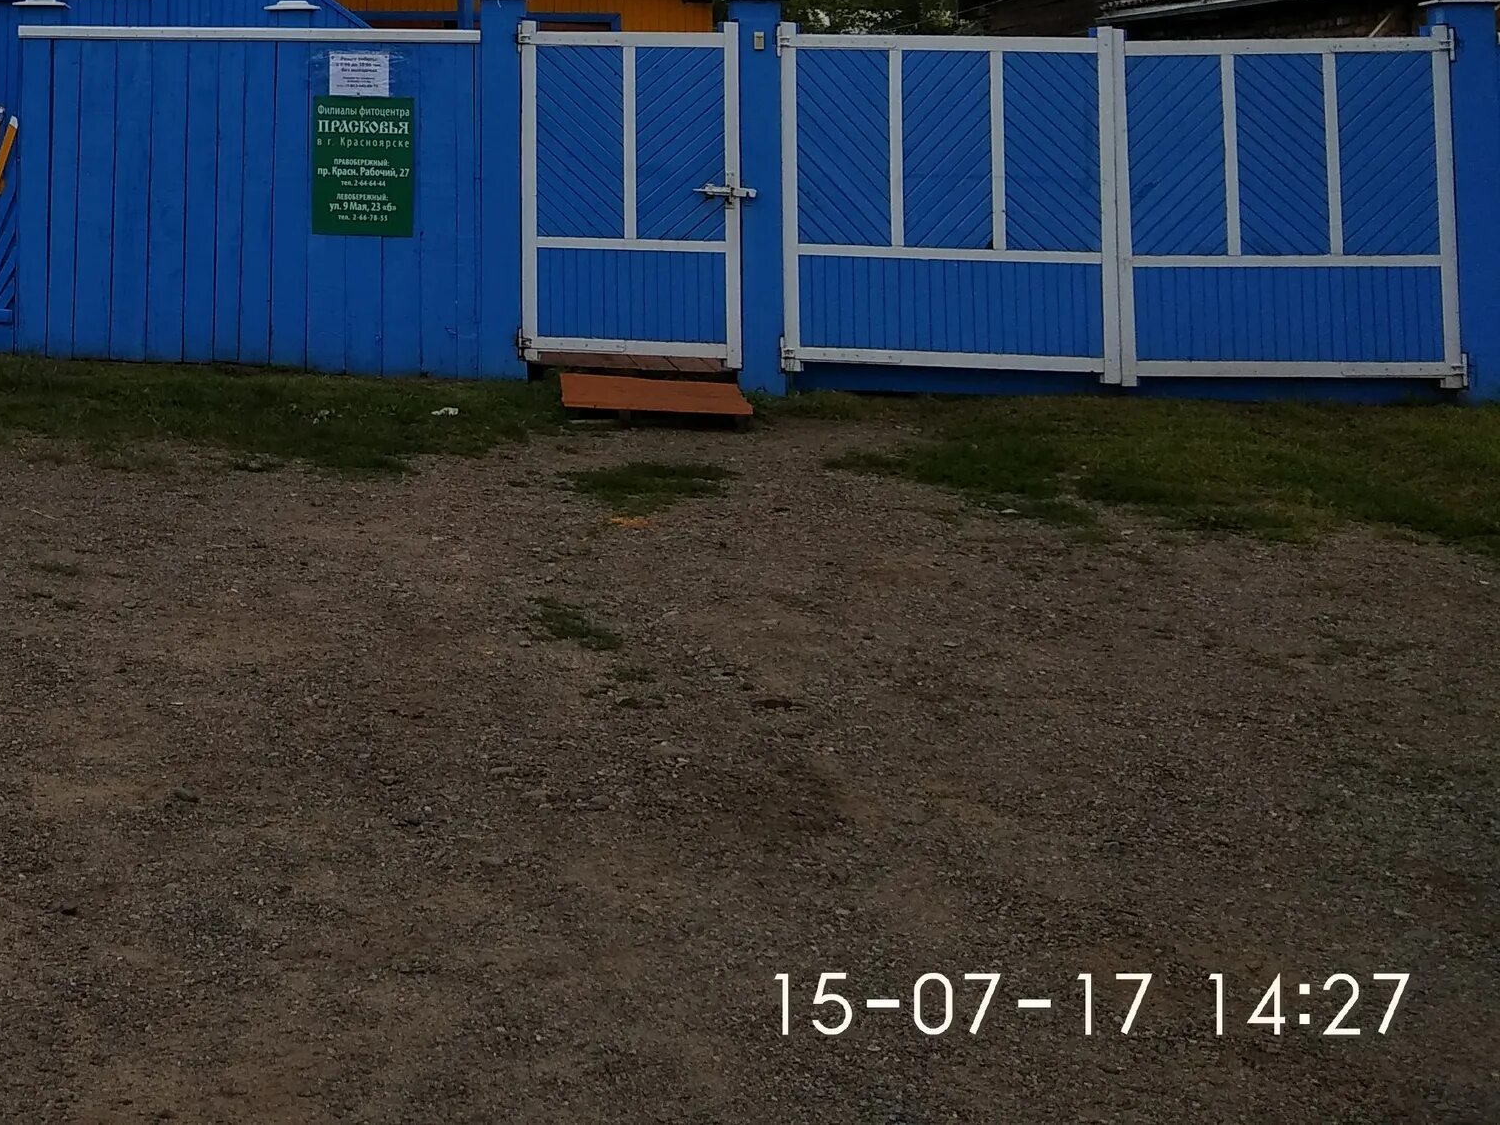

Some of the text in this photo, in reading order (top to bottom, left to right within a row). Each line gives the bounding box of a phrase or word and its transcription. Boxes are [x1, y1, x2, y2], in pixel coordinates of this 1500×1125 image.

[317, 104, 410, 119] Филиалы фитоцентра
[317, 119, 410, 135] ПРАСКОВЬЯ
[317, 138, 322, 146] в
[340, 136, 410, 150] Красноярске
[333, 158, 390, 167] ПРАВОБЕРЕЖНЫЙ:
[317, 166, 410, 178] пр. Красн. Рабочий, 27
[336, 193, 389, 201] ЛЕВОБЕРЕЖНЫЙ:
[329, 202, 342, 212] ул.
[343, 201, 348, 210] 9
[349, 201, 370, 212] Мая,
[371, 202, 381, 211] 23
